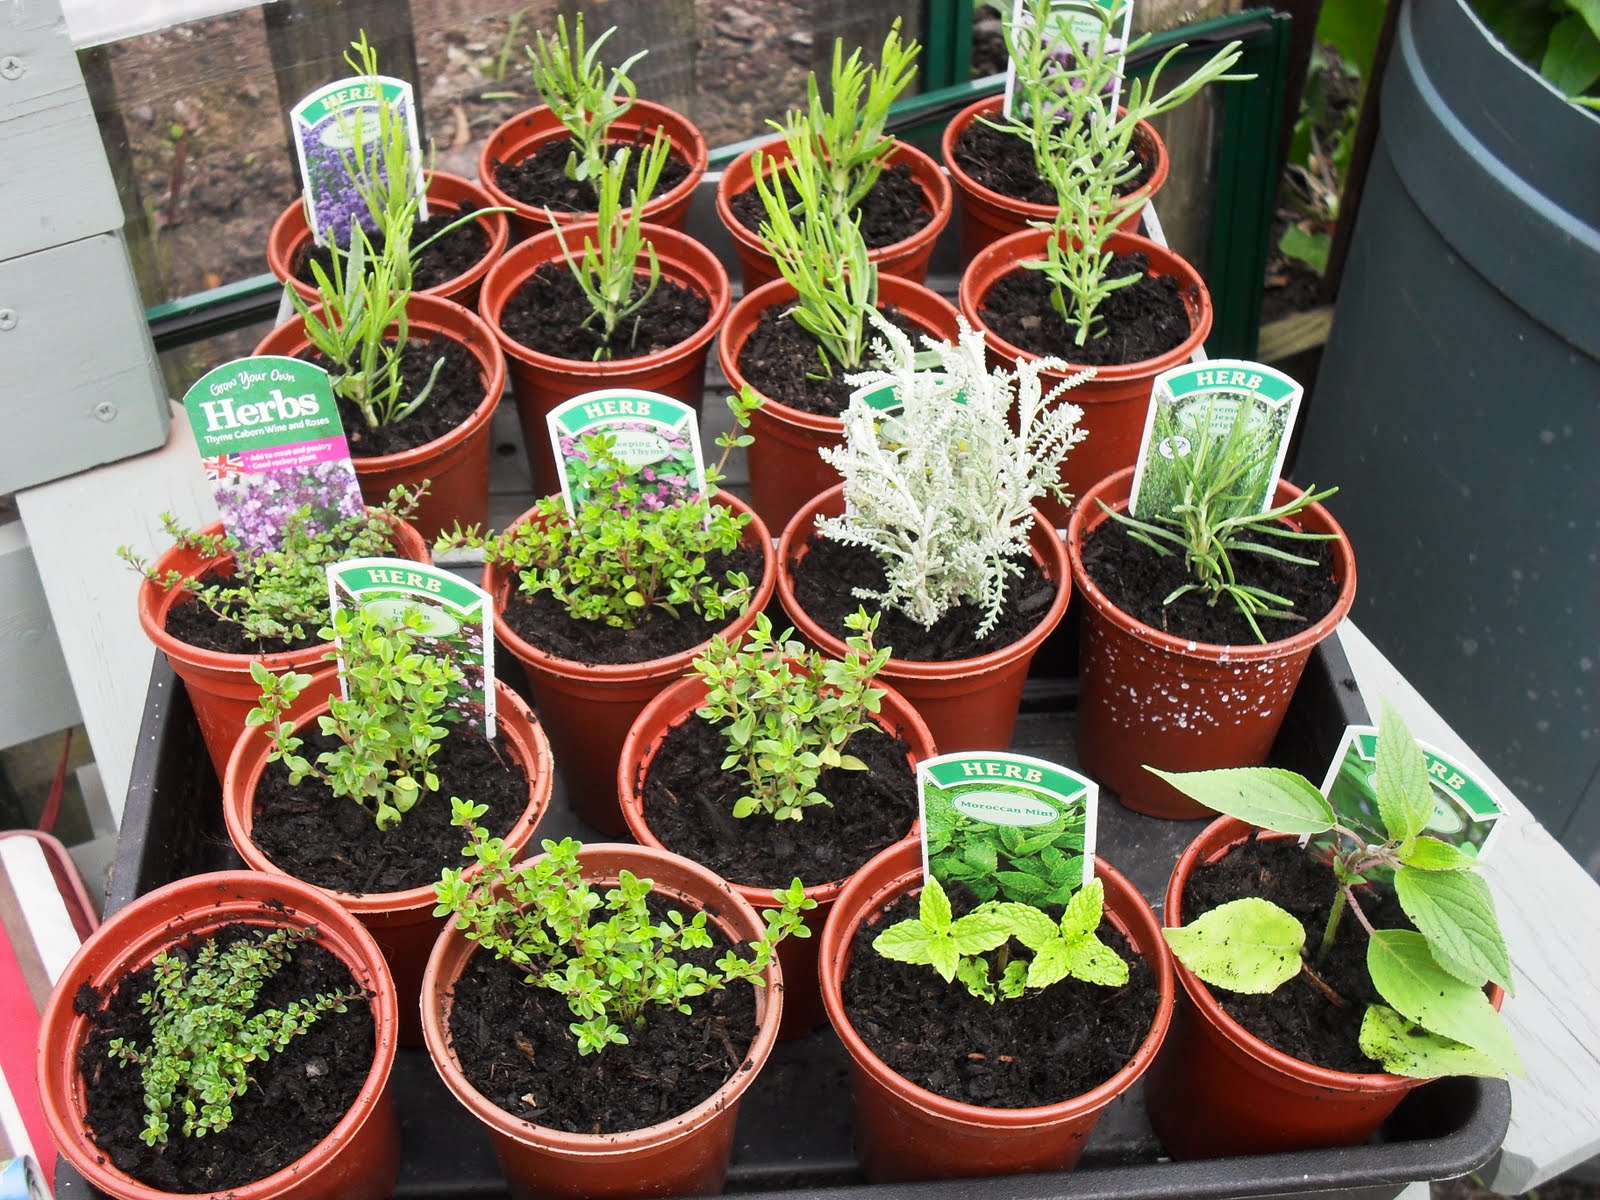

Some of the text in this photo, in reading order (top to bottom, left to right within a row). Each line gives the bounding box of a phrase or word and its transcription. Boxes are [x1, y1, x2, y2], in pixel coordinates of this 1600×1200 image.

[210, 369, 295, 396] Grow Your Own
[1196, 370, 1263, 389] HERB
[199, 389, 320, 432] Herbs
[583, 400, 651, 419] HERB
[204, 417, 330, 445] Thyme Caborn Wine and Roses
[251, 453, 265, 462] Add
[265, 451, 273, 460] to
[293, 446, 305, 455] and
[616, 440, 652, 448] eeping
[252, 460, 271, 470] Good
[367, 569, 442, 593] HERB
[960, 762, 1043, 783] HERB
[1423, 755, 1466, 790] RB
[961, 801, 1054, 817] Moroccan Mint
